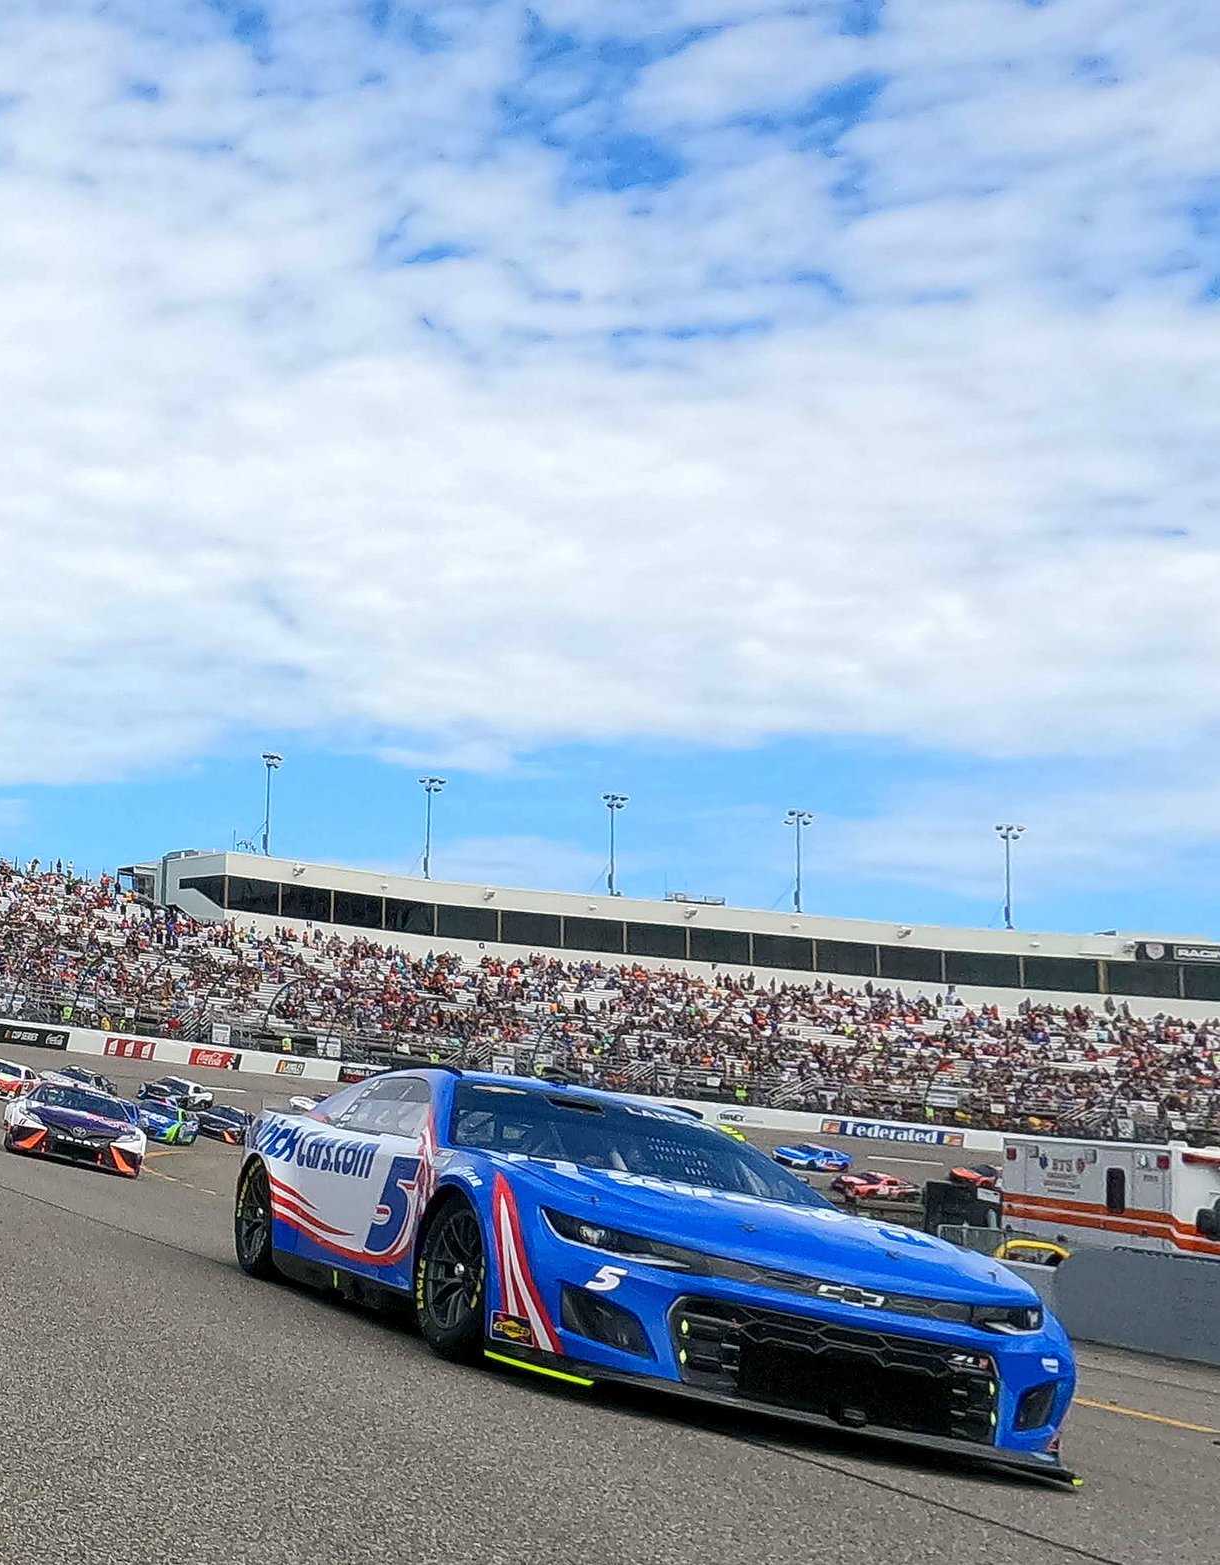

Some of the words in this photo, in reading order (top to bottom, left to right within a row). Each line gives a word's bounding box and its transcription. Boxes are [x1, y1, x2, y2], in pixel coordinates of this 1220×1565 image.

[845, 1121, 939, 1144] Federated
[363, 1155, 425, 1255] 5
[416, 1258, 427, 1310] EAGLE
[584, 1265, 629, 1291] 5
